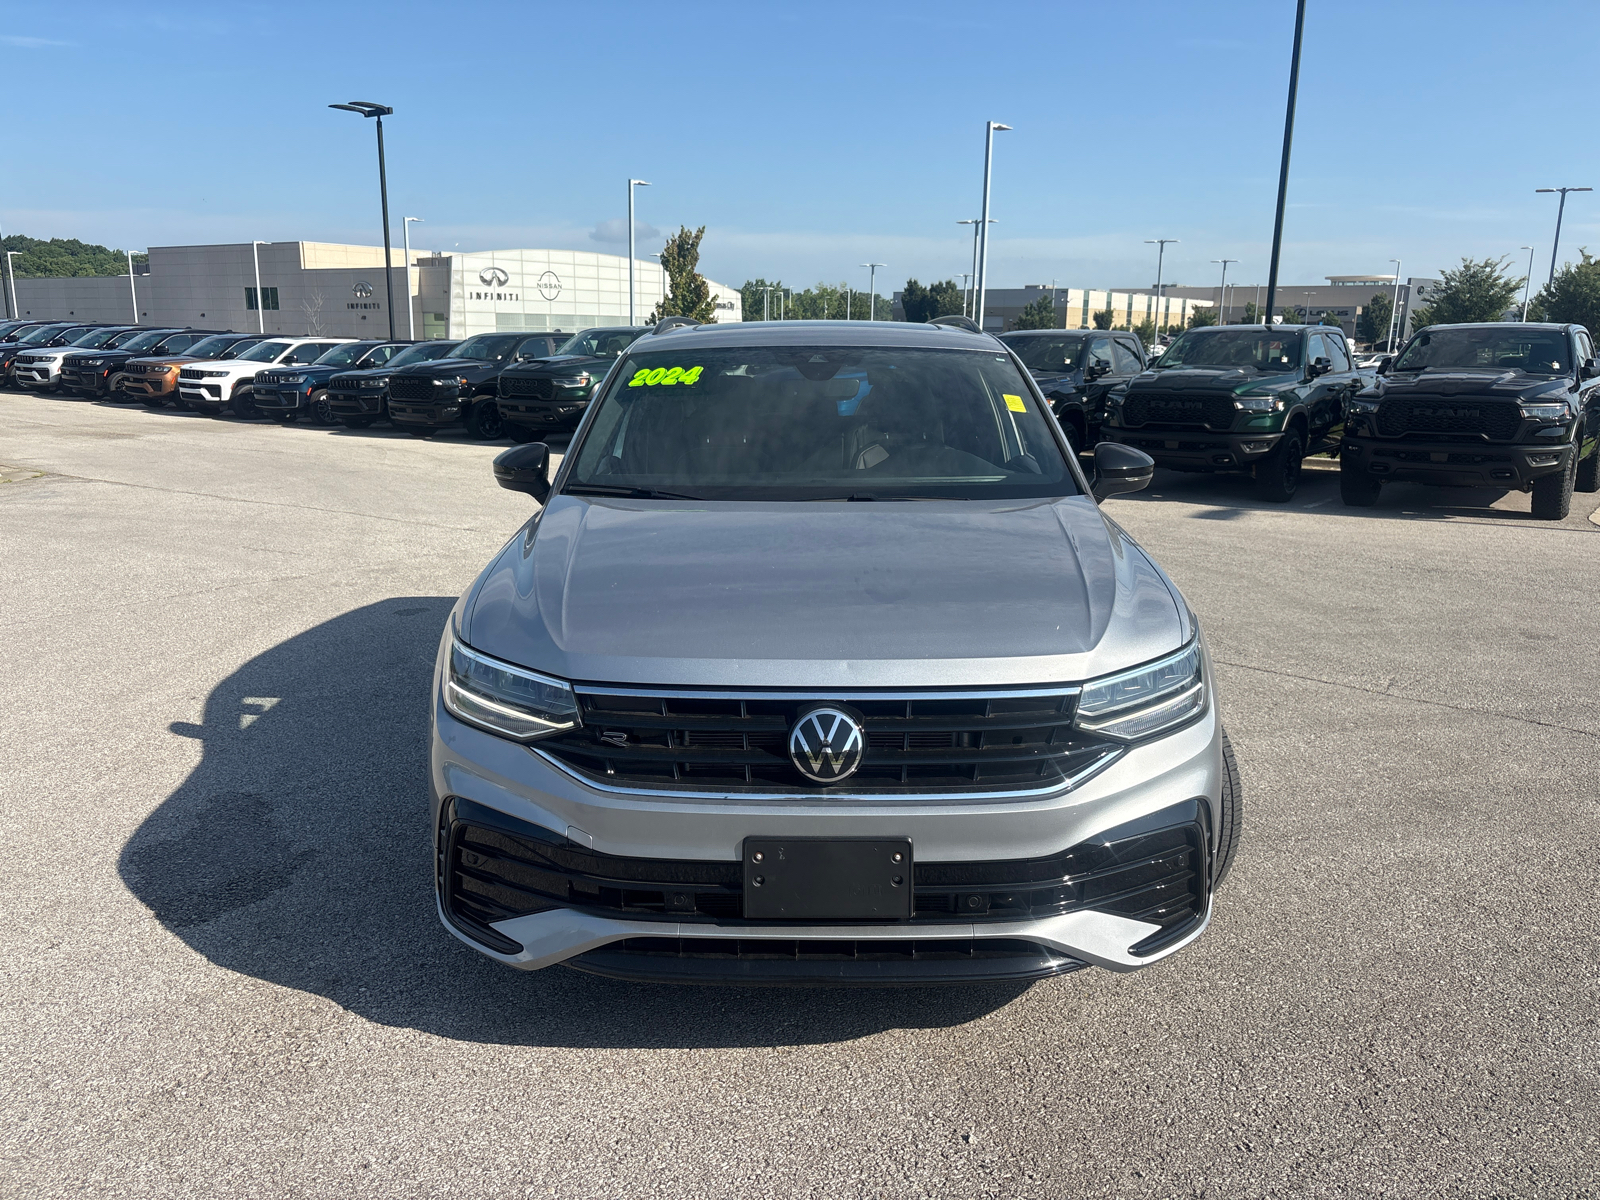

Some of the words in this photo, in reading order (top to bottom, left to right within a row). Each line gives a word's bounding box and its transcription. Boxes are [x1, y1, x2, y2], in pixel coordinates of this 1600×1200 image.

[536, 282, 563, 290] NISSAN
[469, 291, 519, 302] INFINITI
[628, 366, 704, 387] 2024
[509, 379, 538, 387] RAM
[1150, 400, 1203, 409] RAM
[1412, 407, 1480, 417] RAM
